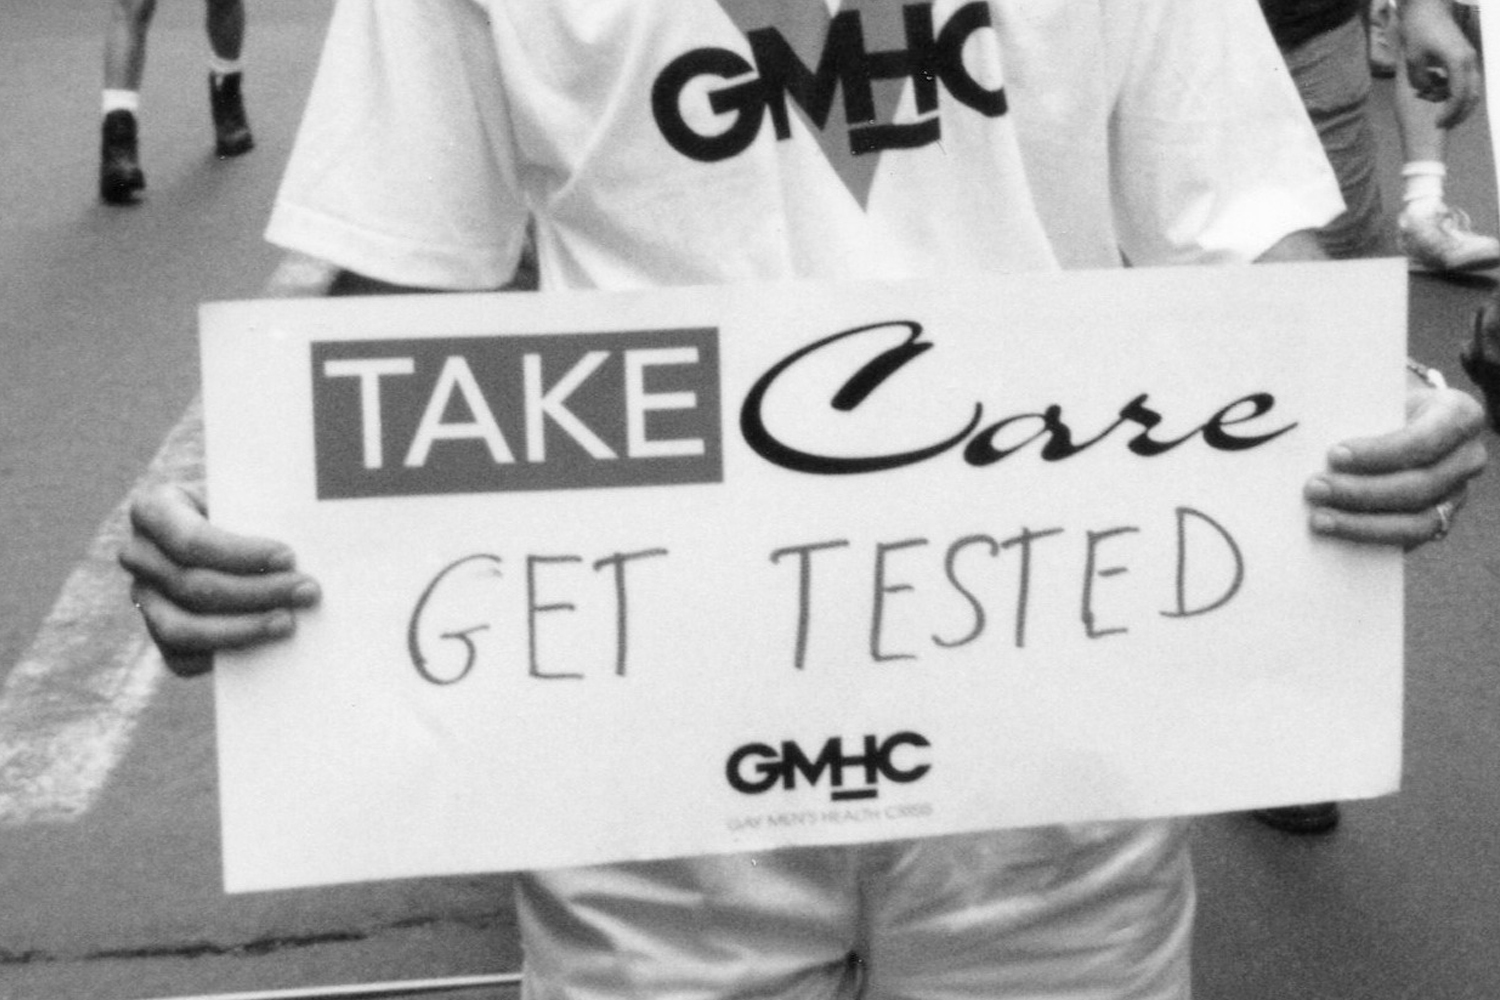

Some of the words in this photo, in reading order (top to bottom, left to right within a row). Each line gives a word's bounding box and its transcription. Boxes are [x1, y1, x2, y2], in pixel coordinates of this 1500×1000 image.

[651, 0, 1009, 163] GMHC
[324, 346, 704, 470] TAKE
[740, 320, 1299, 475] Care
[407, 546, 668, 686] GET
[769, 506, 1246, 670] TESTED
[725, 731, 932, 802] GMHC
